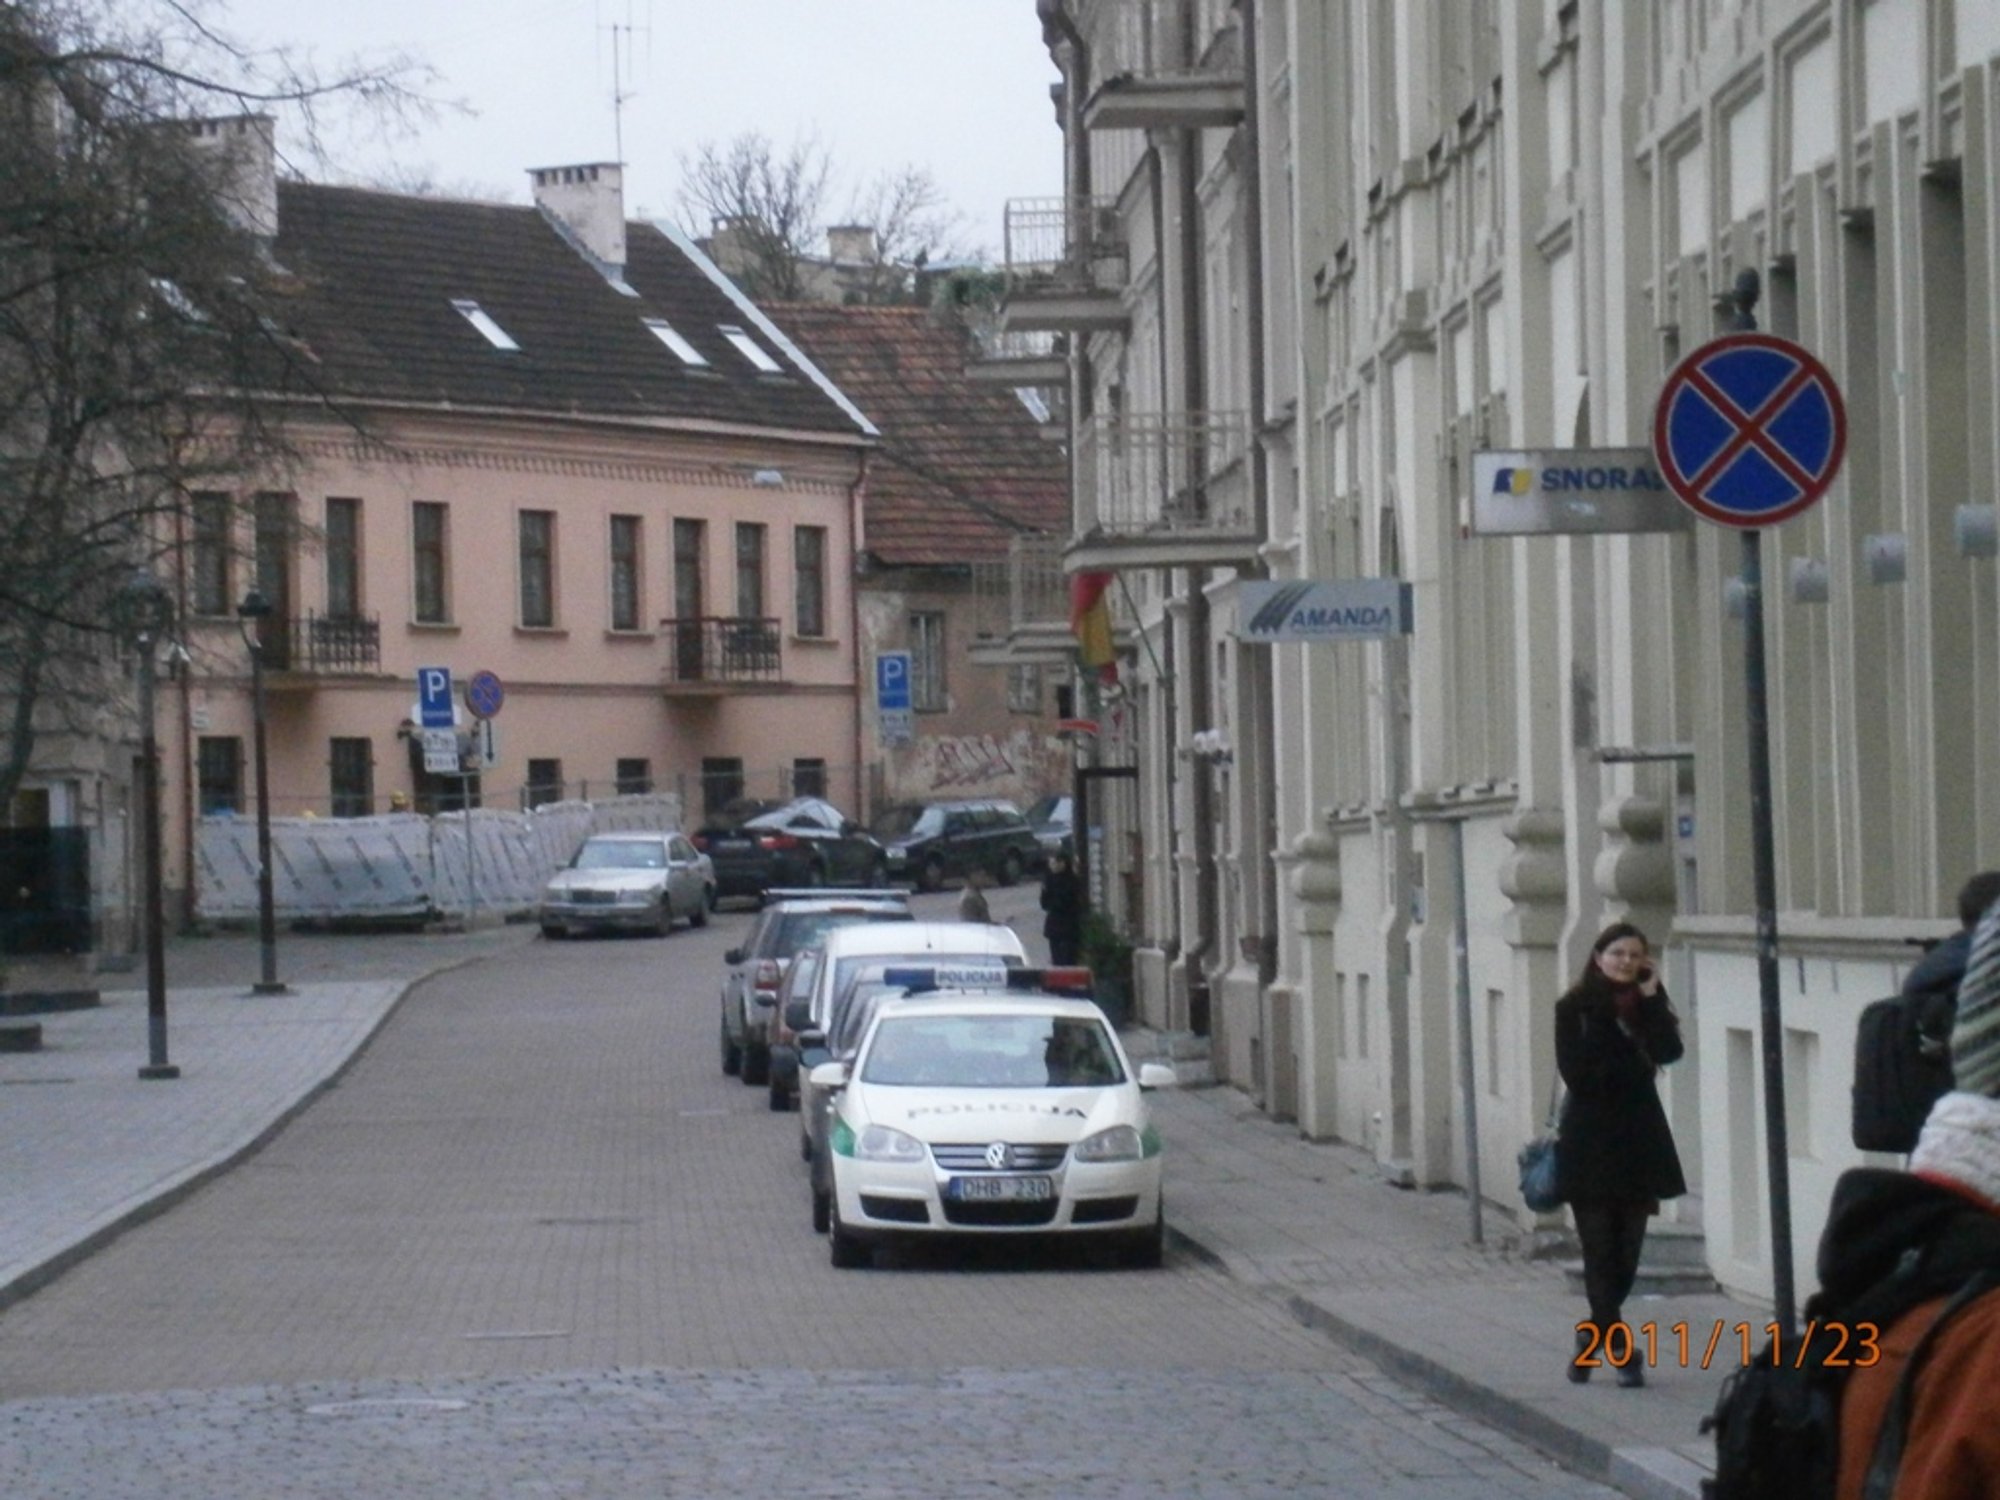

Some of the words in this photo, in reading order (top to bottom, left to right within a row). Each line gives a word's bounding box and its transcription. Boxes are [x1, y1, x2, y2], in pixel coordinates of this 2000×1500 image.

[1291, 606, 1391, 627] AMANDA
[426, 670, 446, 703] P
[884, 658, 903, 689] P
[938, 970, 1003, 983] POLICIJA
